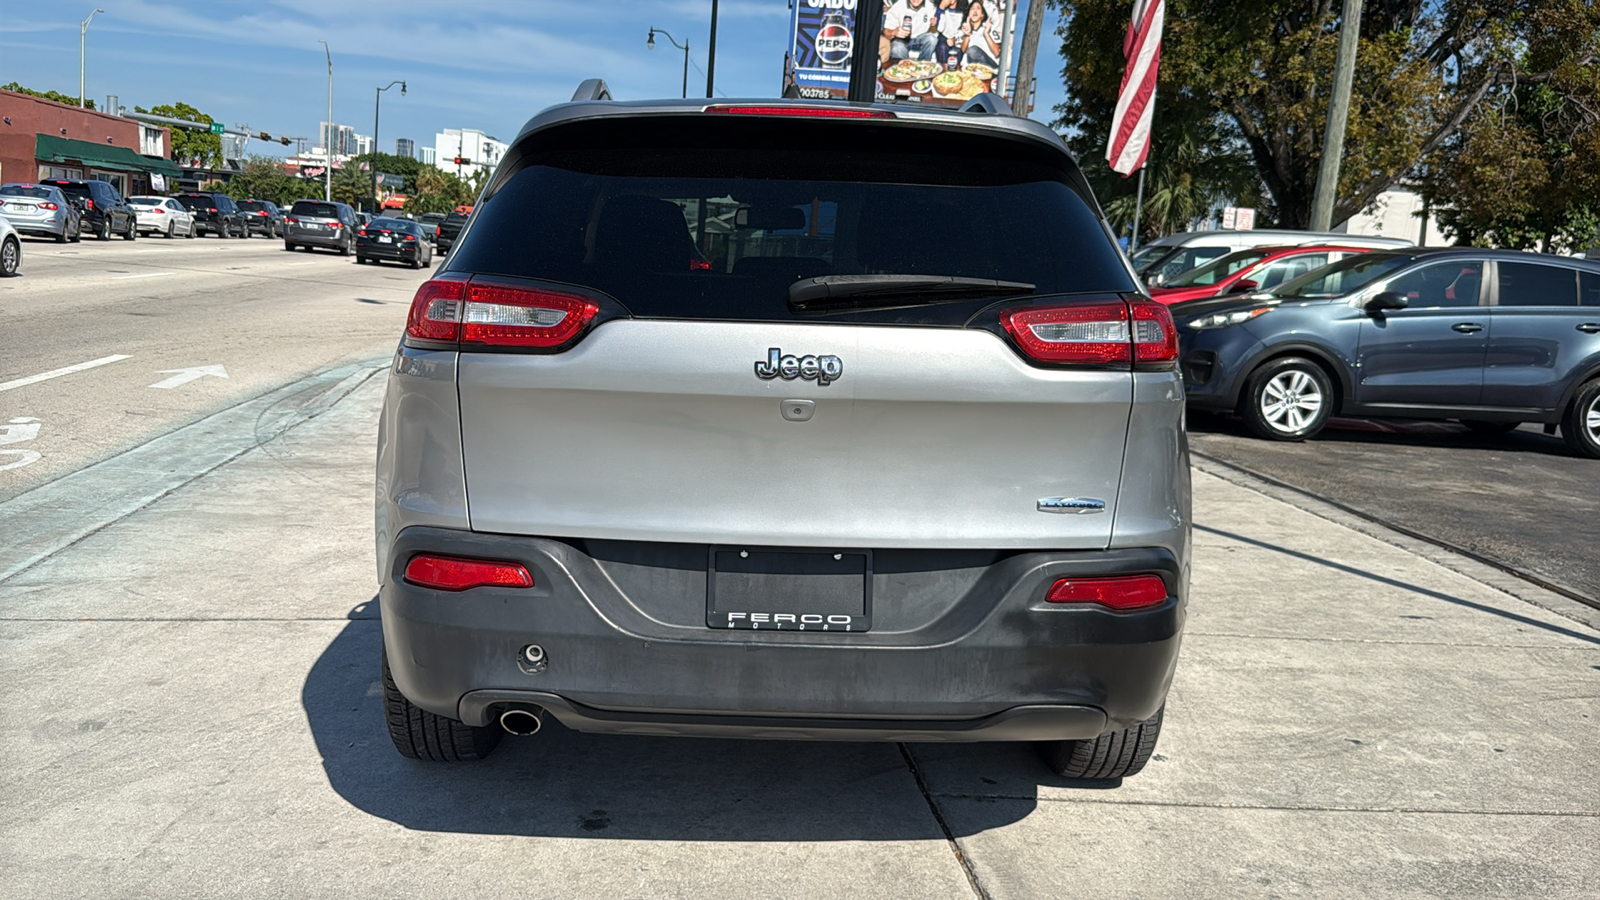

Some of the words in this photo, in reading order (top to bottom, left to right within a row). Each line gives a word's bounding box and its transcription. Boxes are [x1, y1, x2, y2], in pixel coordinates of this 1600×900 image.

[818, 39, 851, 49] PEPSI
[754, 347, 843, 386] Jeep
[728, 612, 851, 624] FERCO
[728, 622, 851, 631] MOTORS
